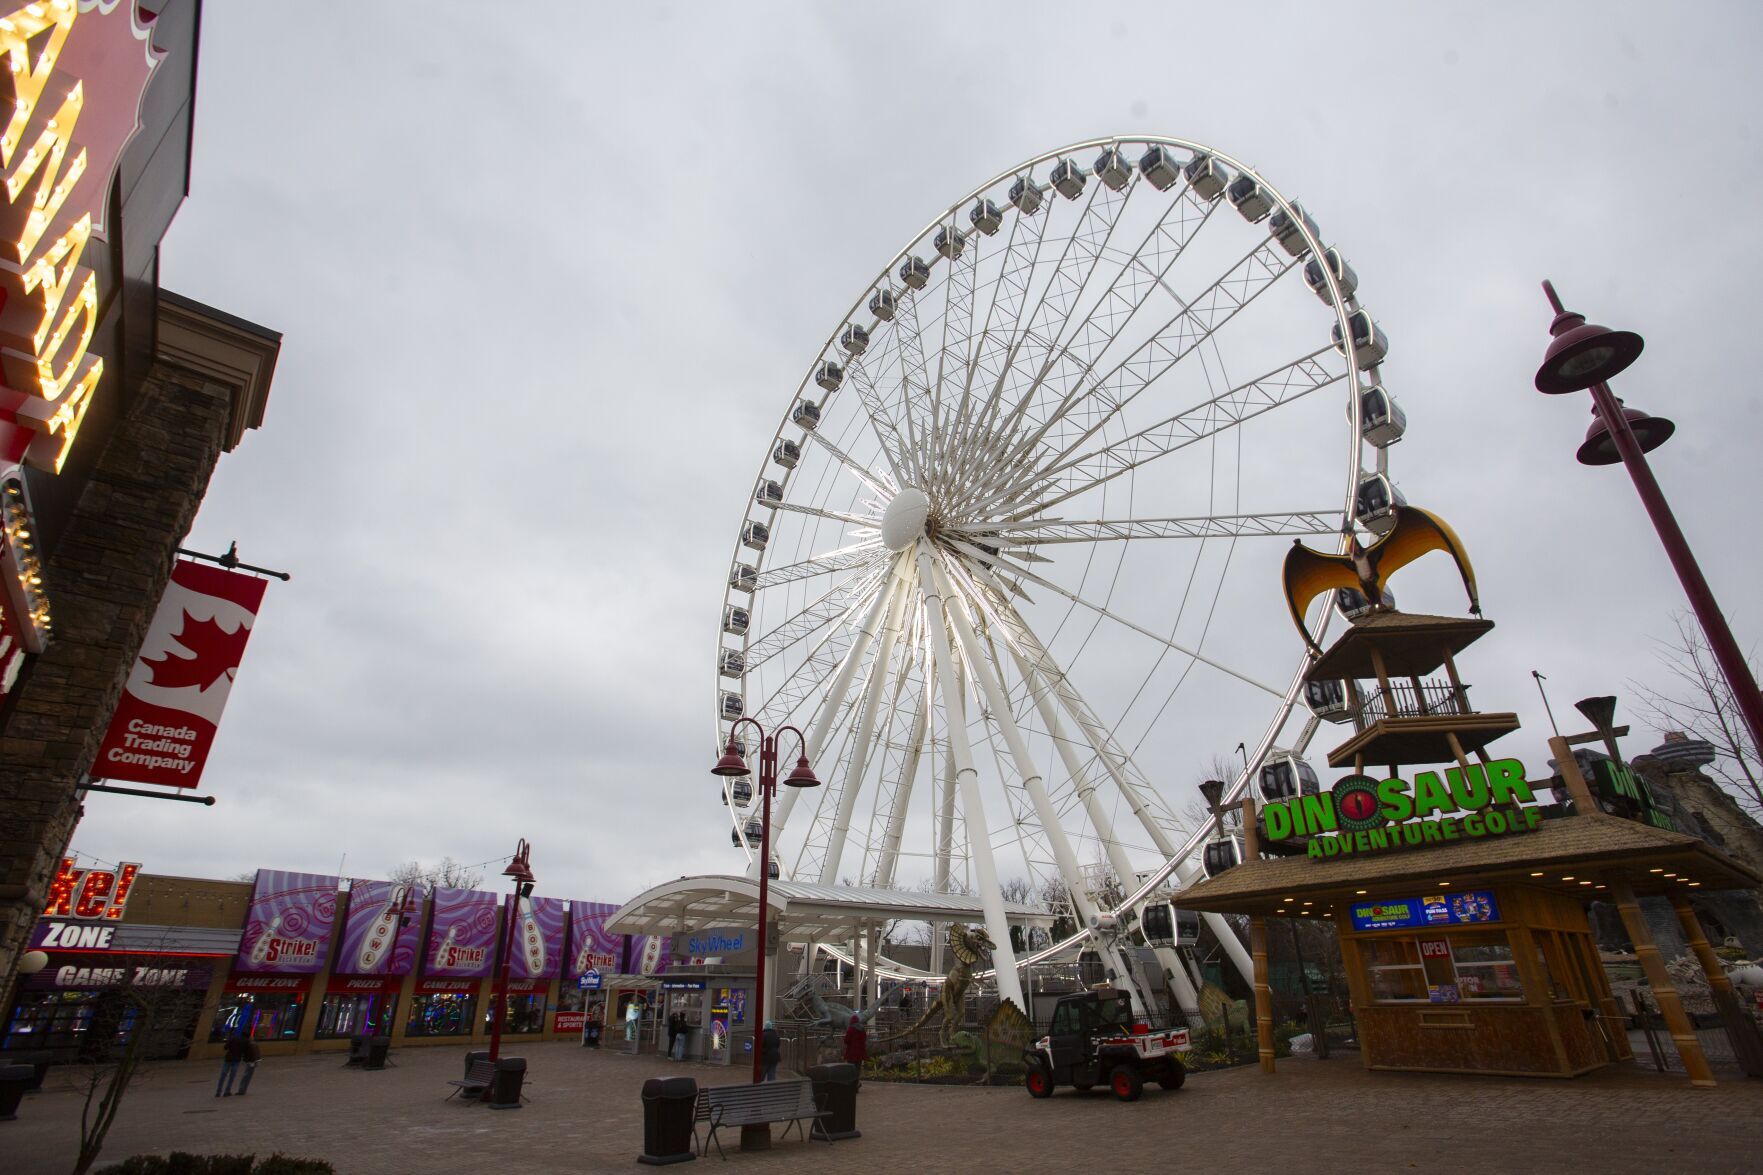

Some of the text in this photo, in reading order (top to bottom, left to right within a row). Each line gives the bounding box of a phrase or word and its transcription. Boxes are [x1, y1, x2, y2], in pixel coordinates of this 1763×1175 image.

[127, 719, 197, 741] Canada
[123, 733, 192, 758] Trading
[107, 748, 196, 774] Company
[1263, 758, 1538, 841] DINOSAUR
[1308, 806, 1543, 859] ADVENTURE GOLF
[41, 922, 115, 949] ZONE
[266, 938, 317, 961] Strike!
[447, 946, 484, 967] Strike!
[1422, 941, 1448, 956] OPEN
[586, 954, 615, 970] Strike!
[55, 965, 188, 986] GAME ZONE
